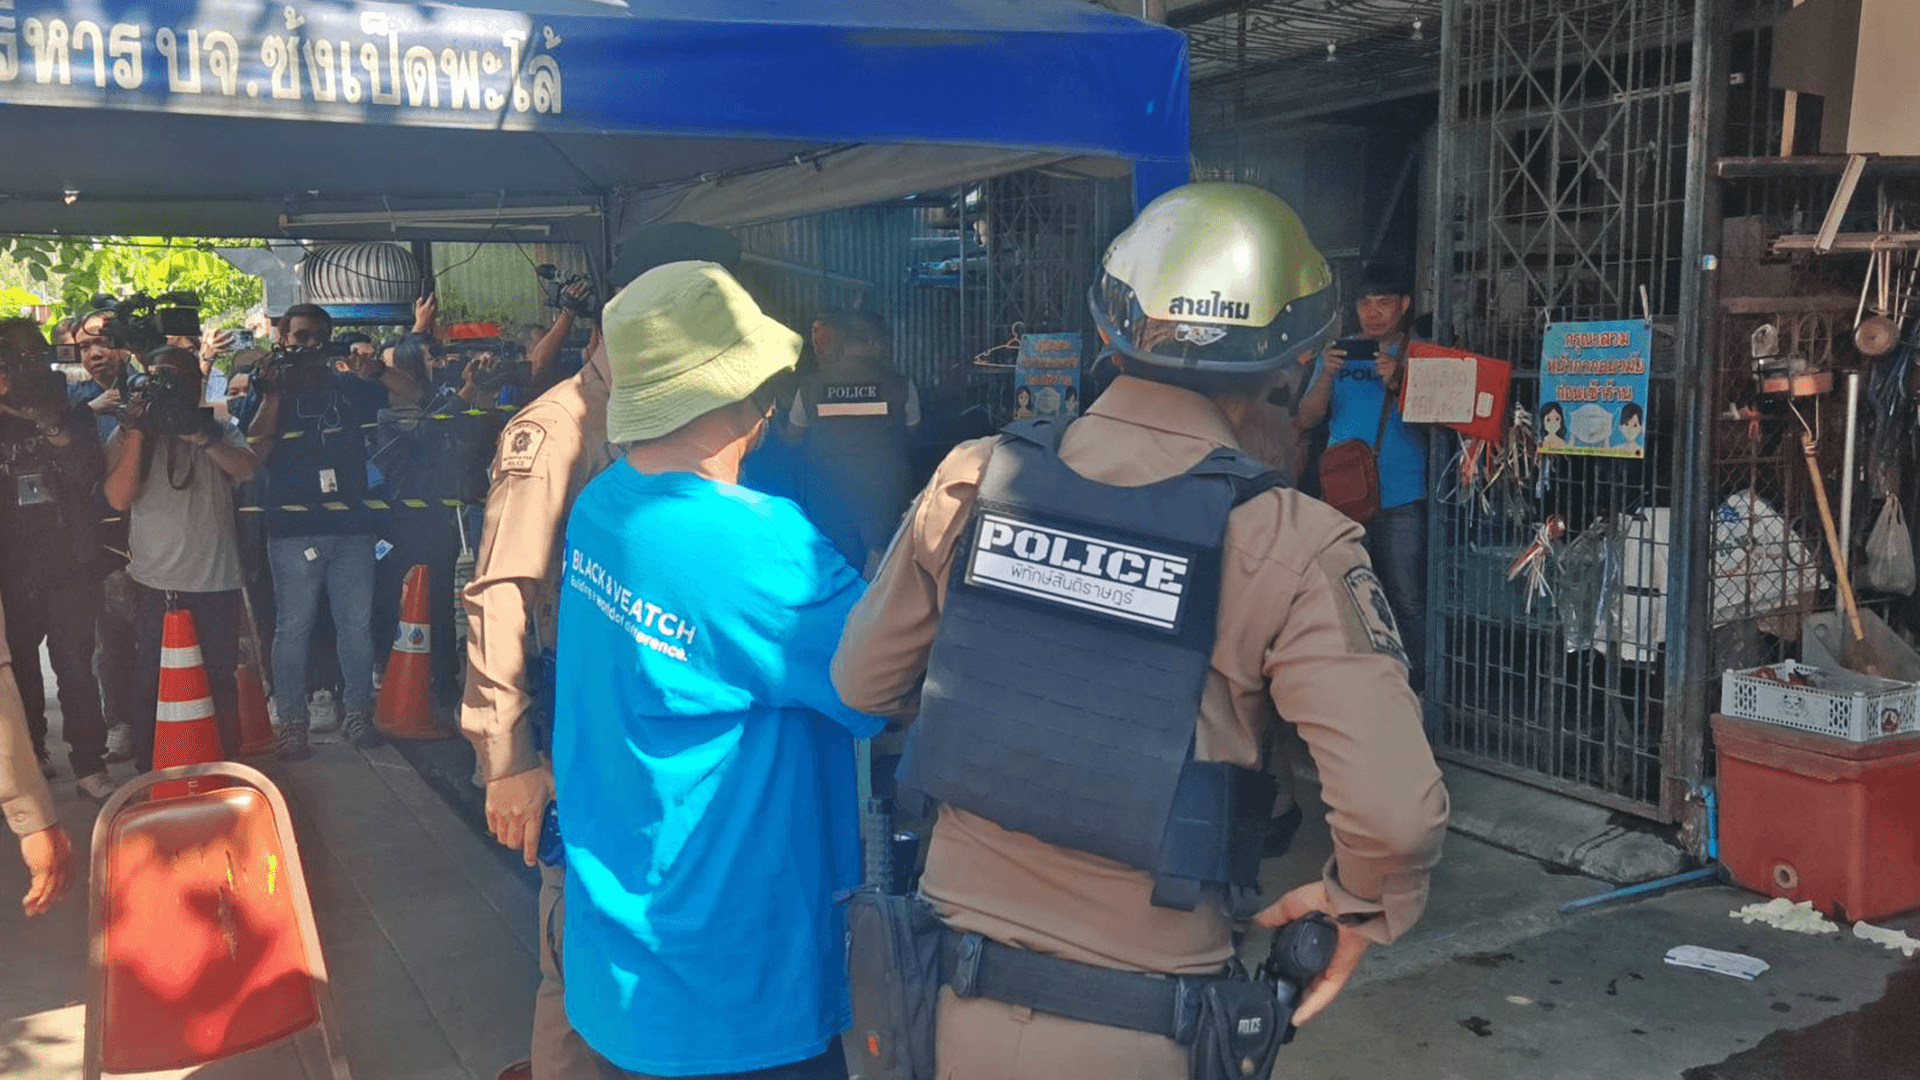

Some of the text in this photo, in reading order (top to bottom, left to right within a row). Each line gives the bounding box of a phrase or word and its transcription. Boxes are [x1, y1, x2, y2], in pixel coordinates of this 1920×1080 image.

[0, 0, 143, 90] รหาร
[1168, 290, 1250, 320] สายไหม
[1564, 331, 1630, 354] กรุณาสวม
[1339, 368, 1380, 382] POL
[827, 385, 877, 399] POLICE
[978, 520, 1187, 594] POLICE
[1010, 561, 1137, 606] พิทักษ์สันติราษฎร์
